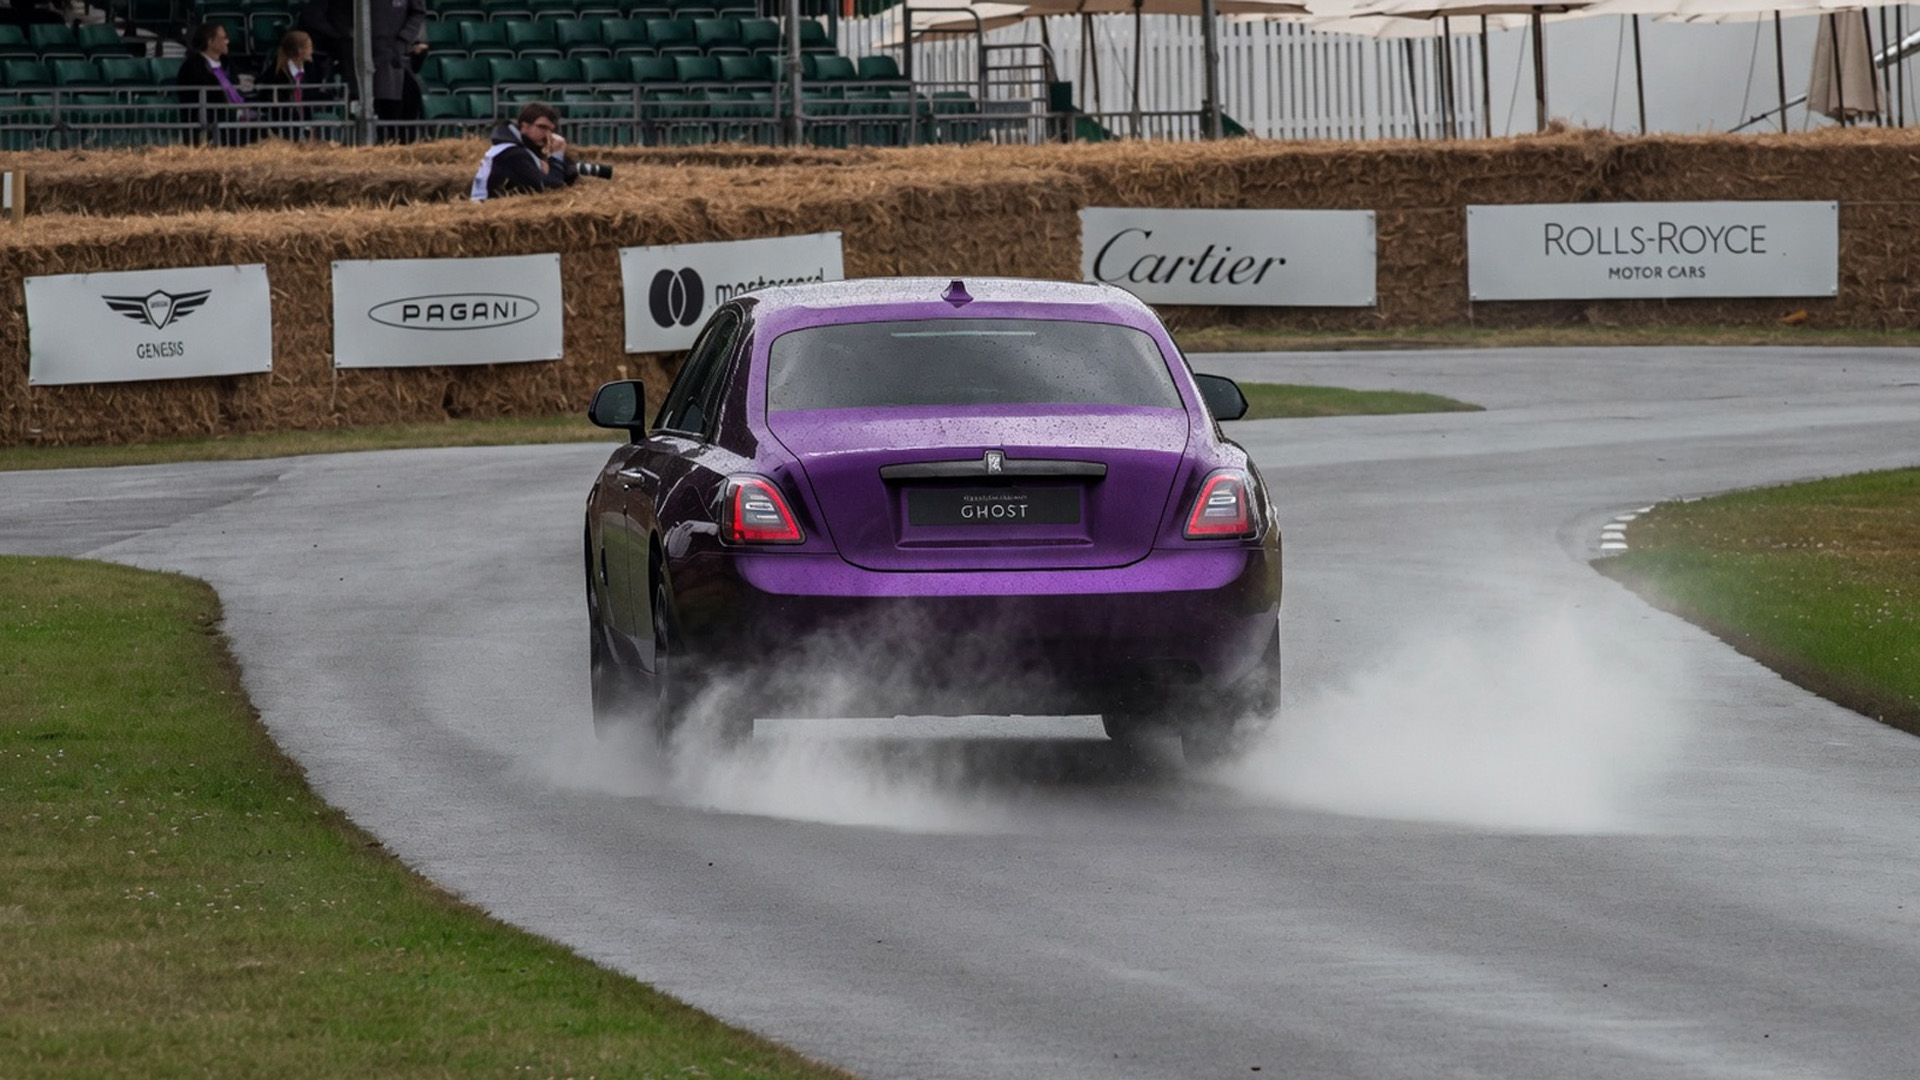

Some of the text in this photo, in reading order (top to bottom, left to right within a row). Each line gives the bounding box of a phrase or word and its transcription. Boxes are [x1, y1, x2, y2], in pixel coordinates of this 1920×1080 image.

[1545, 222, 1767, 256] ROLLS-ROYCE
[1093, 227, 1287, 285] Cartier
[1609, 266, 1706, 280] MOTOR CARS
[402, 301, 518, 322] PAGANI
[136, 341, 184, 359] GENESIS
[961, 504, 1028, 519] GHOST
